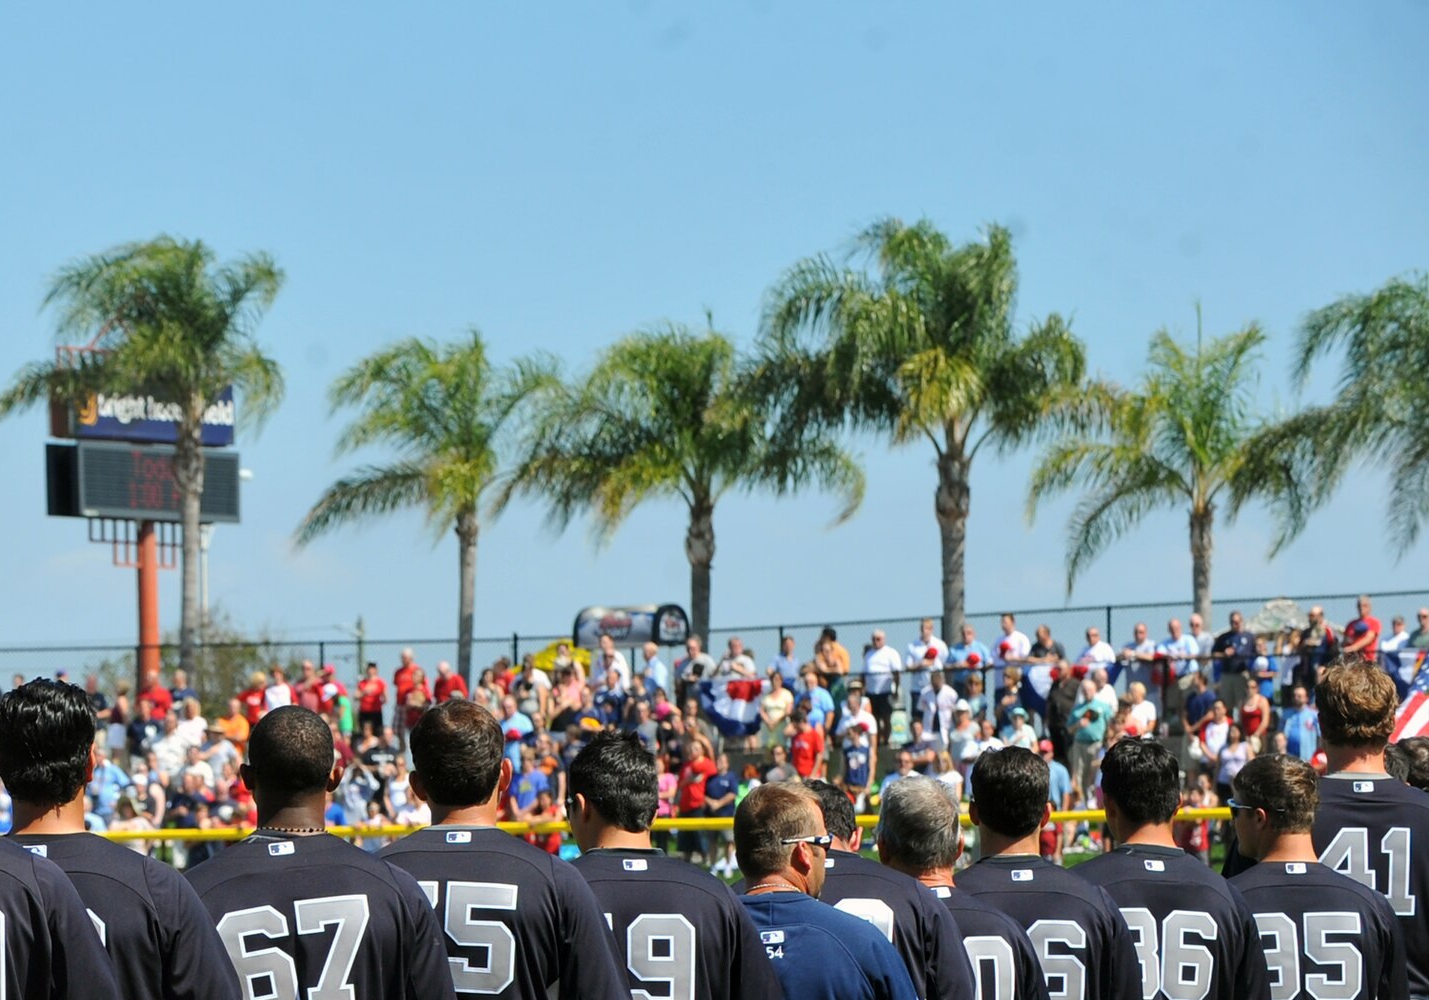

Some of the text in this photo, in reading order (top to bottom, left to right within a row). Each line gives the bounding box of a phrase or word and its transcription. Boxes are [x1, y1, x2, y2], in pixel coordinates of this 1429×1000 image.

[1317, 827, 1416, 916] 41
[417, 880, 519, 994] 5
[765, 945, 784, 960] 54
